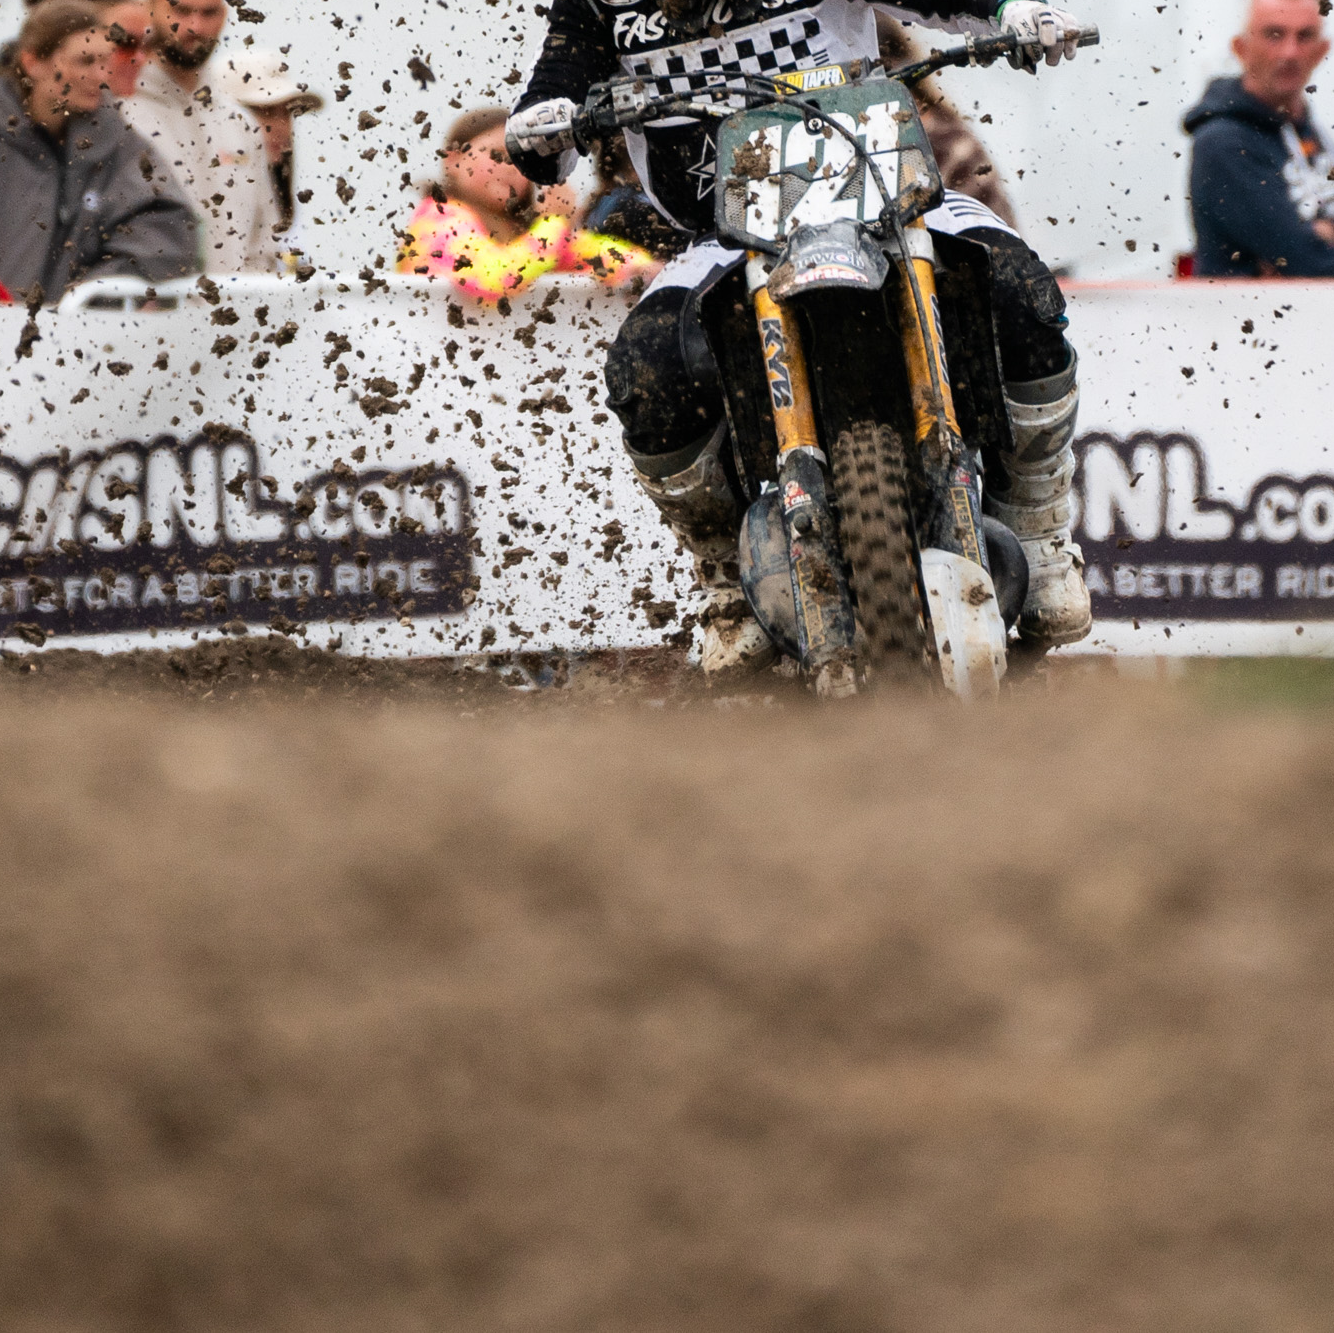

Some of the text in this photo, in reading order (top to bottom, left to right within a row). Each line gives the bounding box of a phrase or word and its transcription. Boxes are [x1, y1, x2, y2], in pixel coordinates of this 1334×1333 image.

[746, 100, 901, 242] 121
[64, 574, 137, 610] FOR
[141, 572, 164, 605] A
[1113, 563, 1264, 599] BETTER
